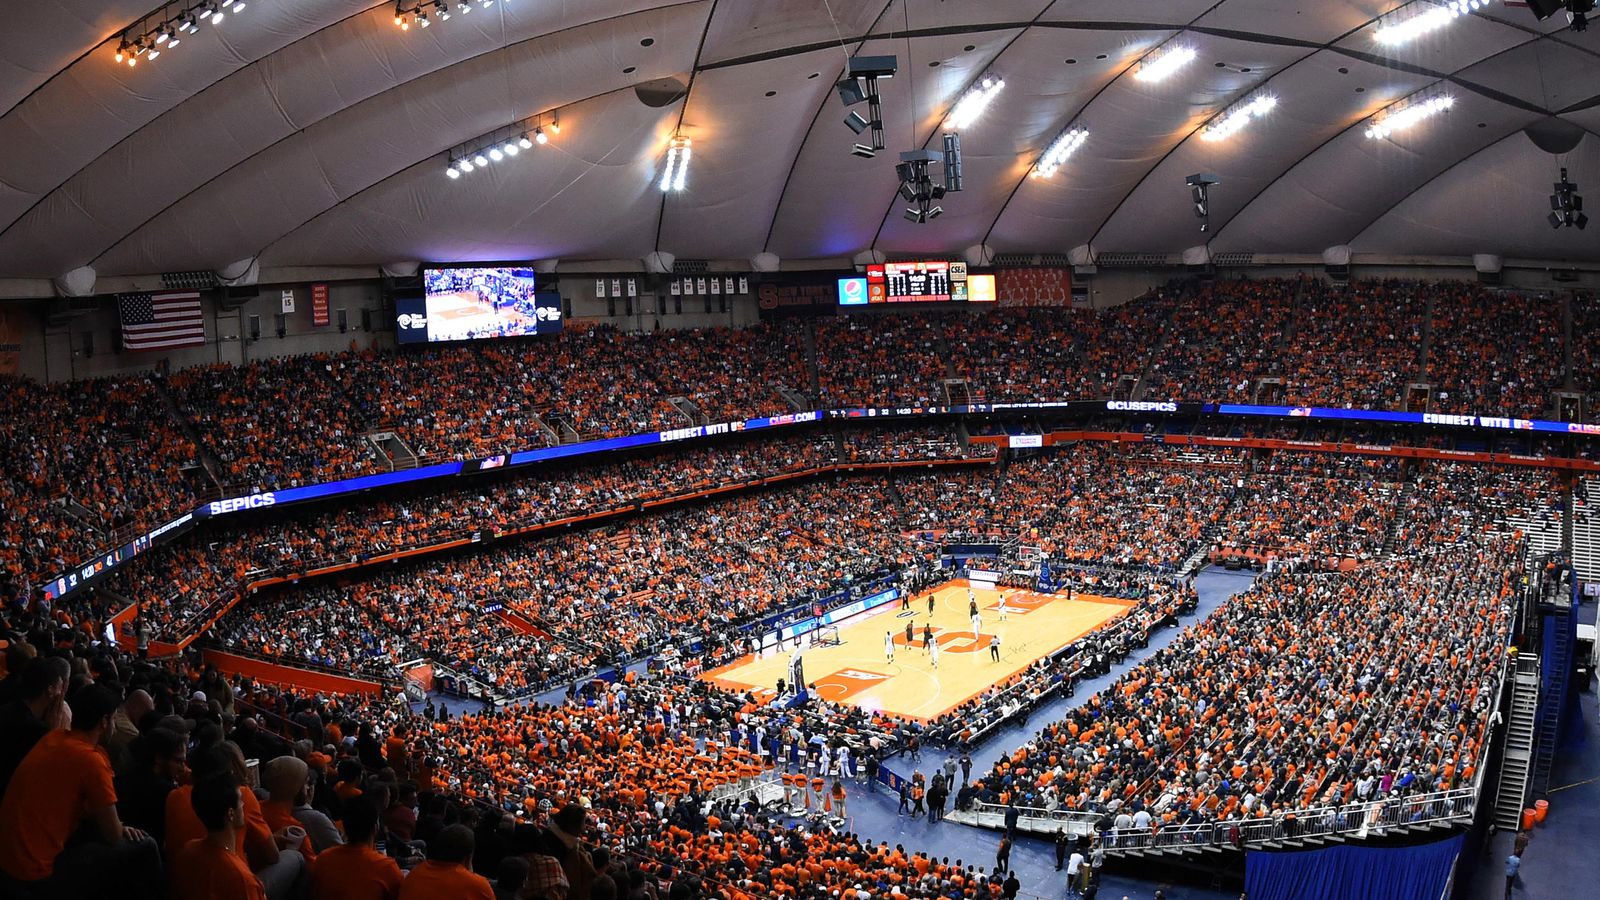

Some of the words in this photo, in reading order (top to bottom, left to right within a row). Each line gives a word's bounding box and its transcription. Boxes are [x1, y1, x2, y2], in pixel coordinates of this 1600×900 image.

[1107, 401, 1176, 412] @CUSEPICS
[660, 426, 702, 442] CONNECT
[706, 423, 728, 435] WITH
[769, 412, 815, 425] CUSE.COM
[1423, 413, 1476, 426] CONNECT
[1480, 416, 1510, 428] WITH
[210, 491, 275, 515] SEPICS
[486, 604, 502, 612] DELTA
